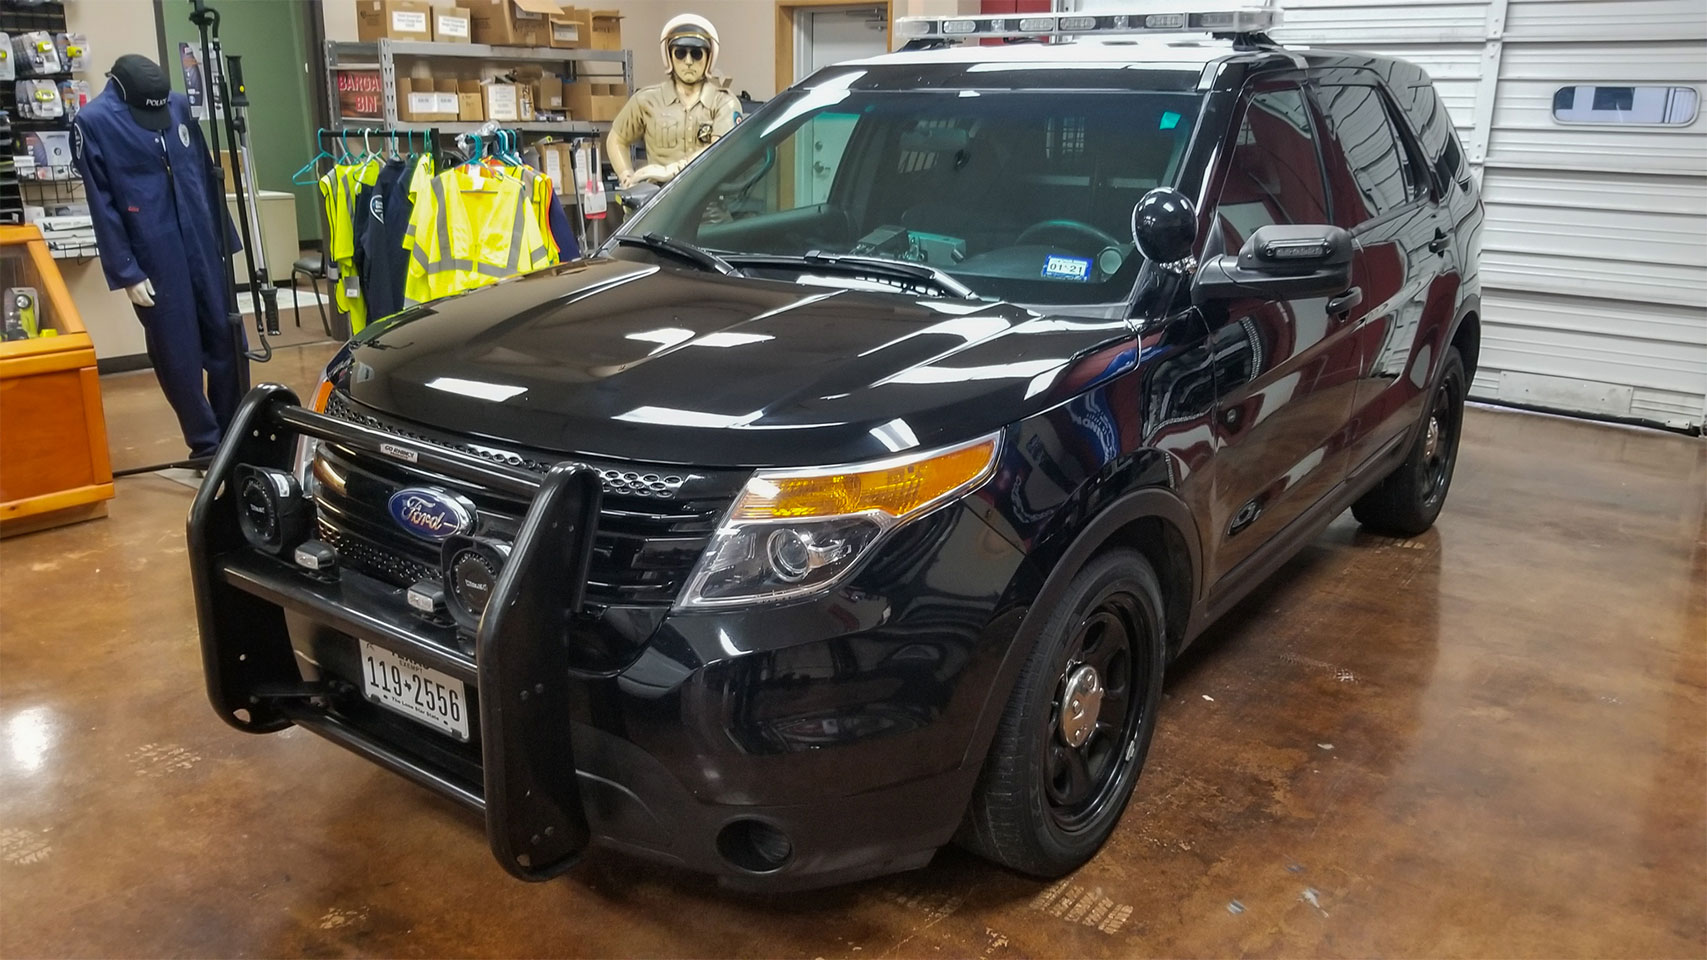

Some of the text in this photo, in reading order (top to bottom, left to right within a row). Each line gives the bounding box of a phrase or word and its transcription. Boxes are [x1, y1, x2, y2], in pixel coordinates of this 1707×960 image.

[355, 95, 378, 113] BIN
[401, 496, 450, 531] Ford
[398, 660, 424, 674] EXEMPT
[367, 656, 403, 697] 119
[412, 674, 460, 722] 2556
[391, 696, 440, 721] The Lone Star State
